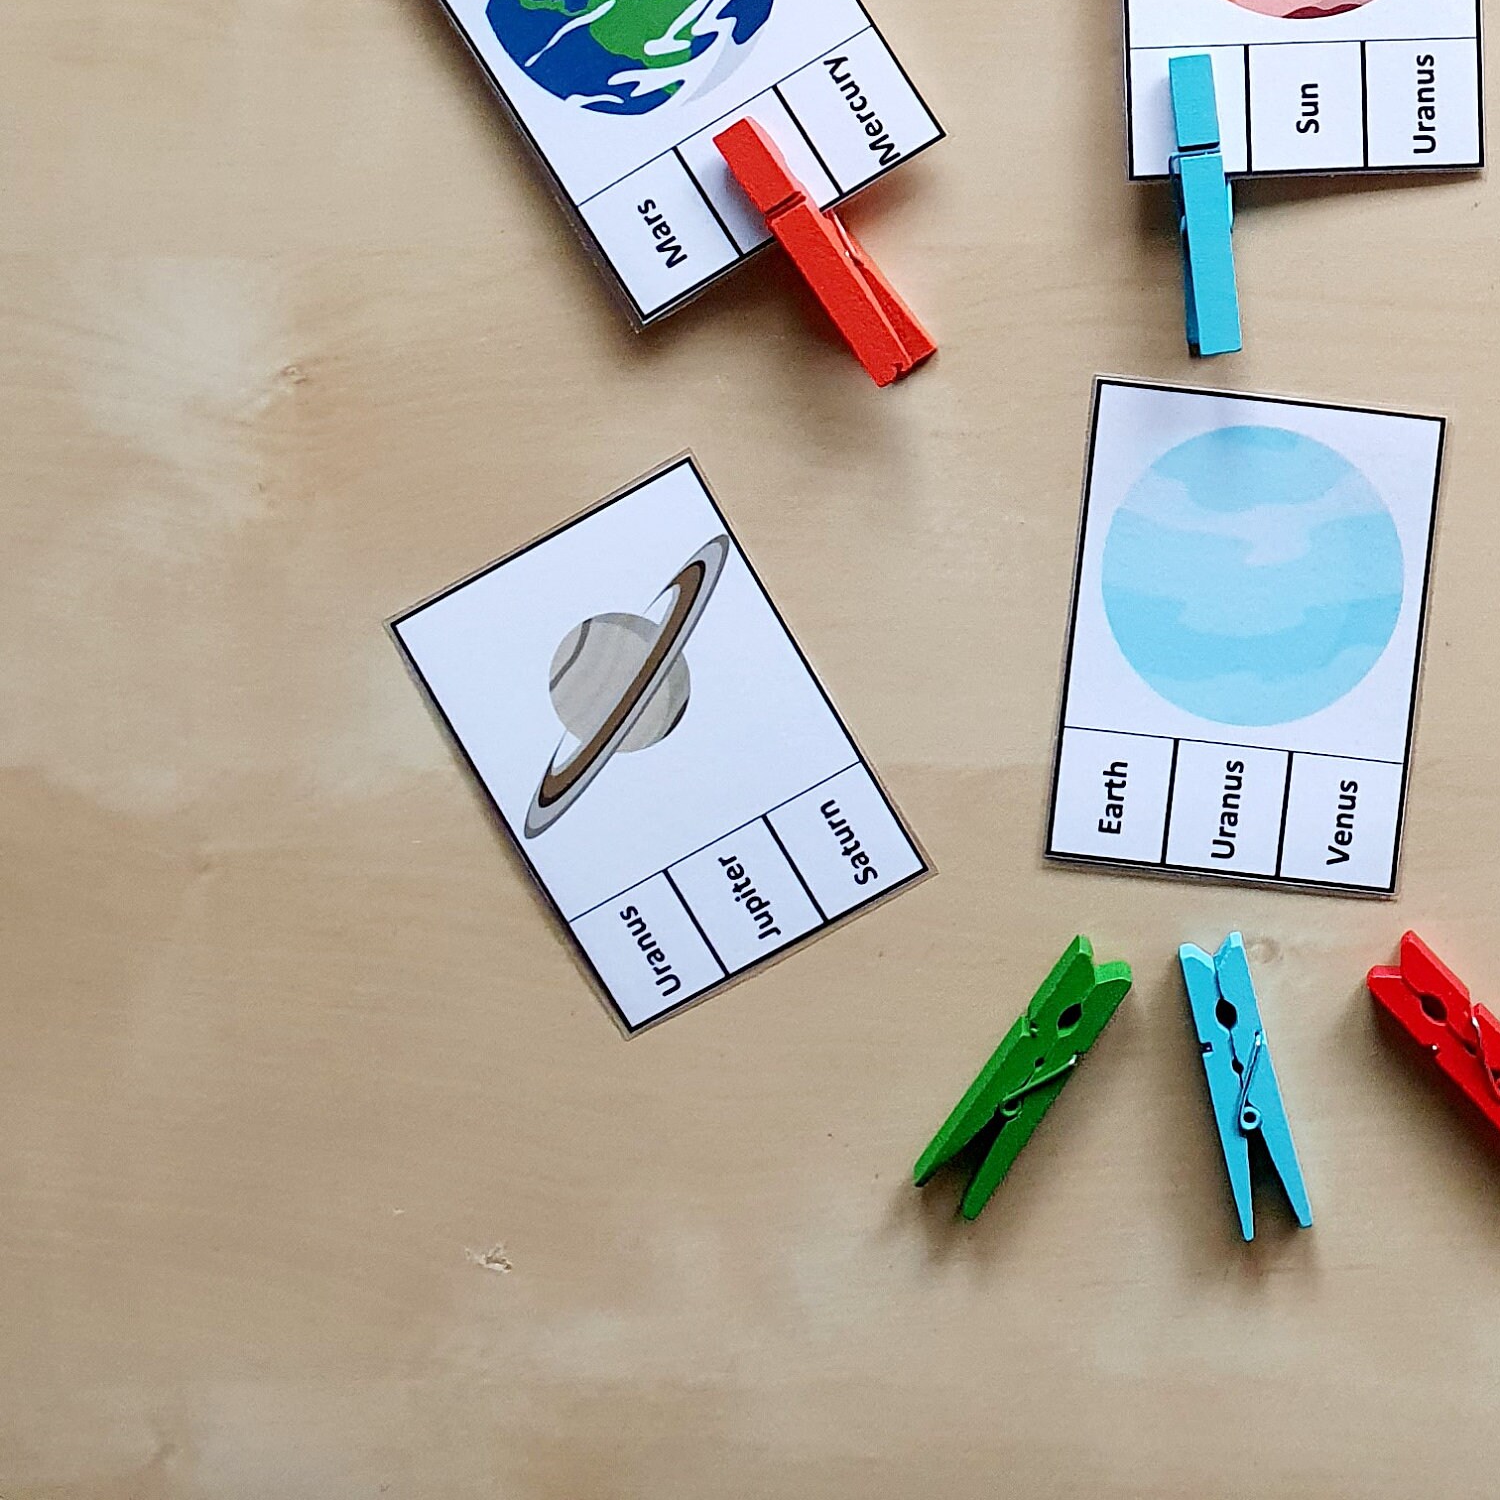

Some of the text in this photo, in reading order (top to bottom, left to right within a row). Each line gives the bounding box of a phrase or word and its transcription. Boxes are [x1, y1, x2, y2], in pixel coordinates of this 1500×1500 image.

[823, 55, 901, 167] Mercury
[1296, 82, 1320, 134] Sun
[1413, 53, 1437, 155] Uranus
[637, 198, 688, 269] Mars
[1098, 760, 1129, 834] Earth
[1210, 759, 1245, 859] Uranus
[1325, 779, 1358, 865] Venus
[819, 799, 878, 885] Saturn
[717, 854, 782, 939] Jupiter
[620, 904, 681, 997] Uranus
